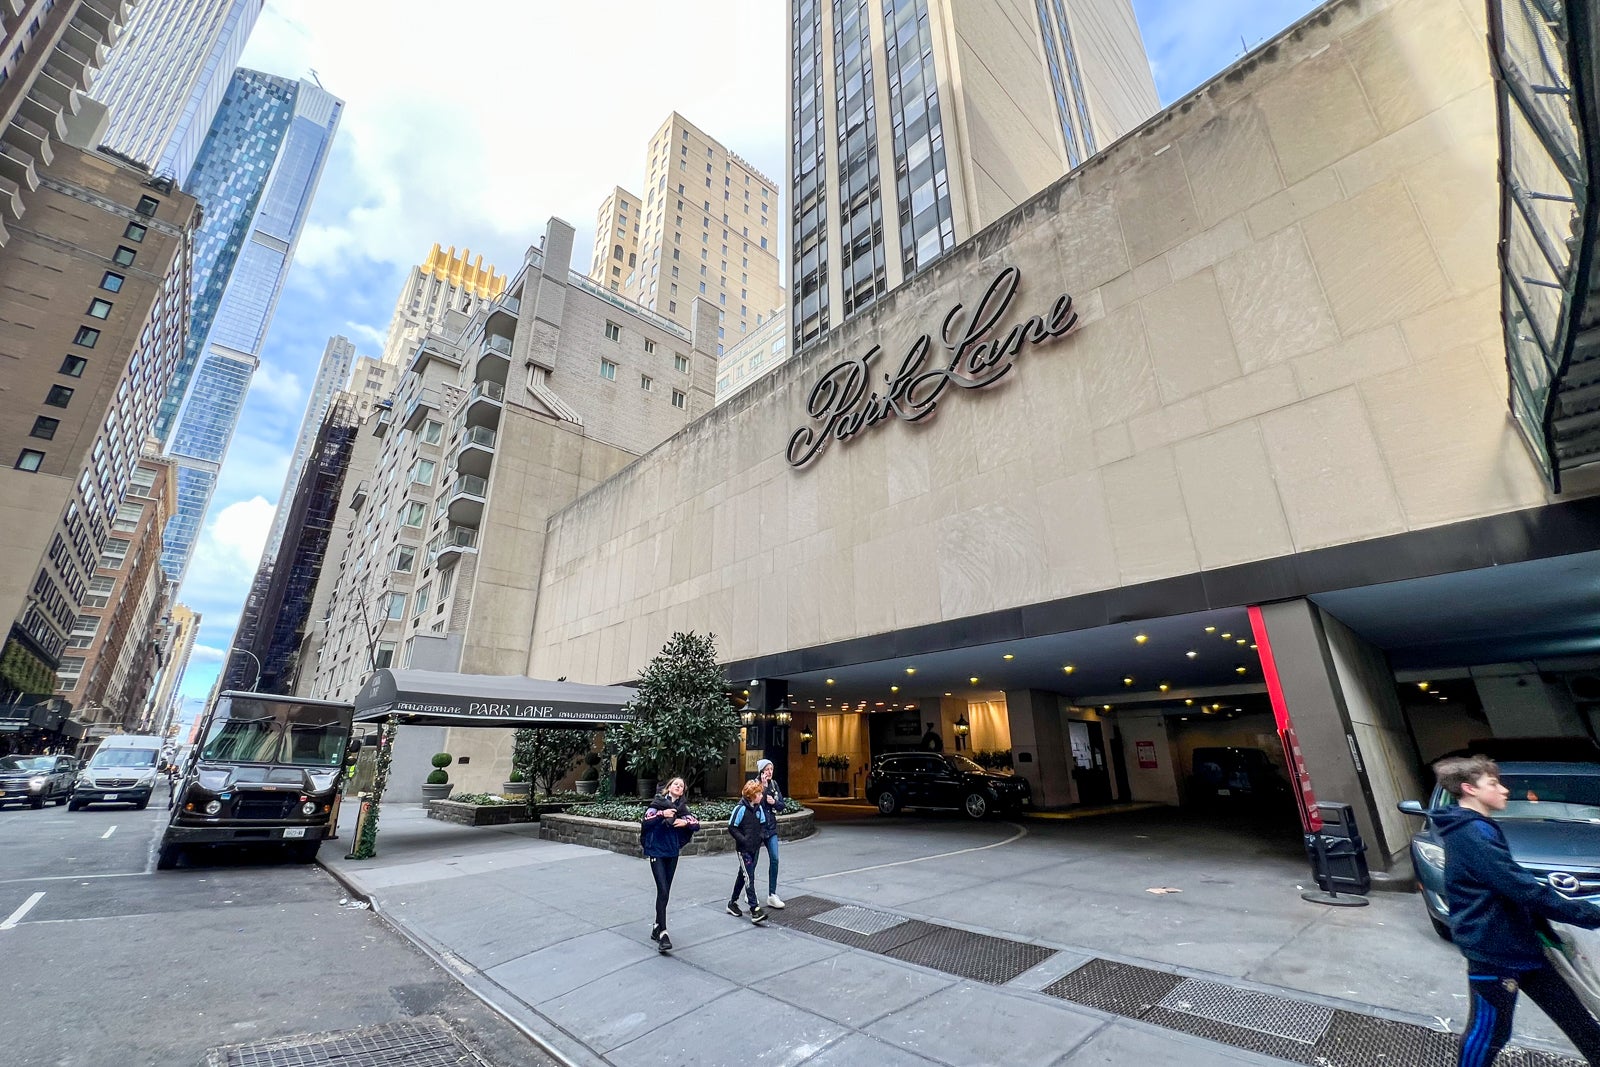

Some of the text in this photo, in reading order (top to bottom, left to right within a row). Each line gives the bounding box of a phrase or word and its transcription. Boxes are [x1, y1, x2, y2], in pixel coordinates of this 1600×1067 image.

[785, 265, 1079, 467] Park Lane
[469, 703, 510, 716] PARK
[515, 705, 554, 718] LANE
